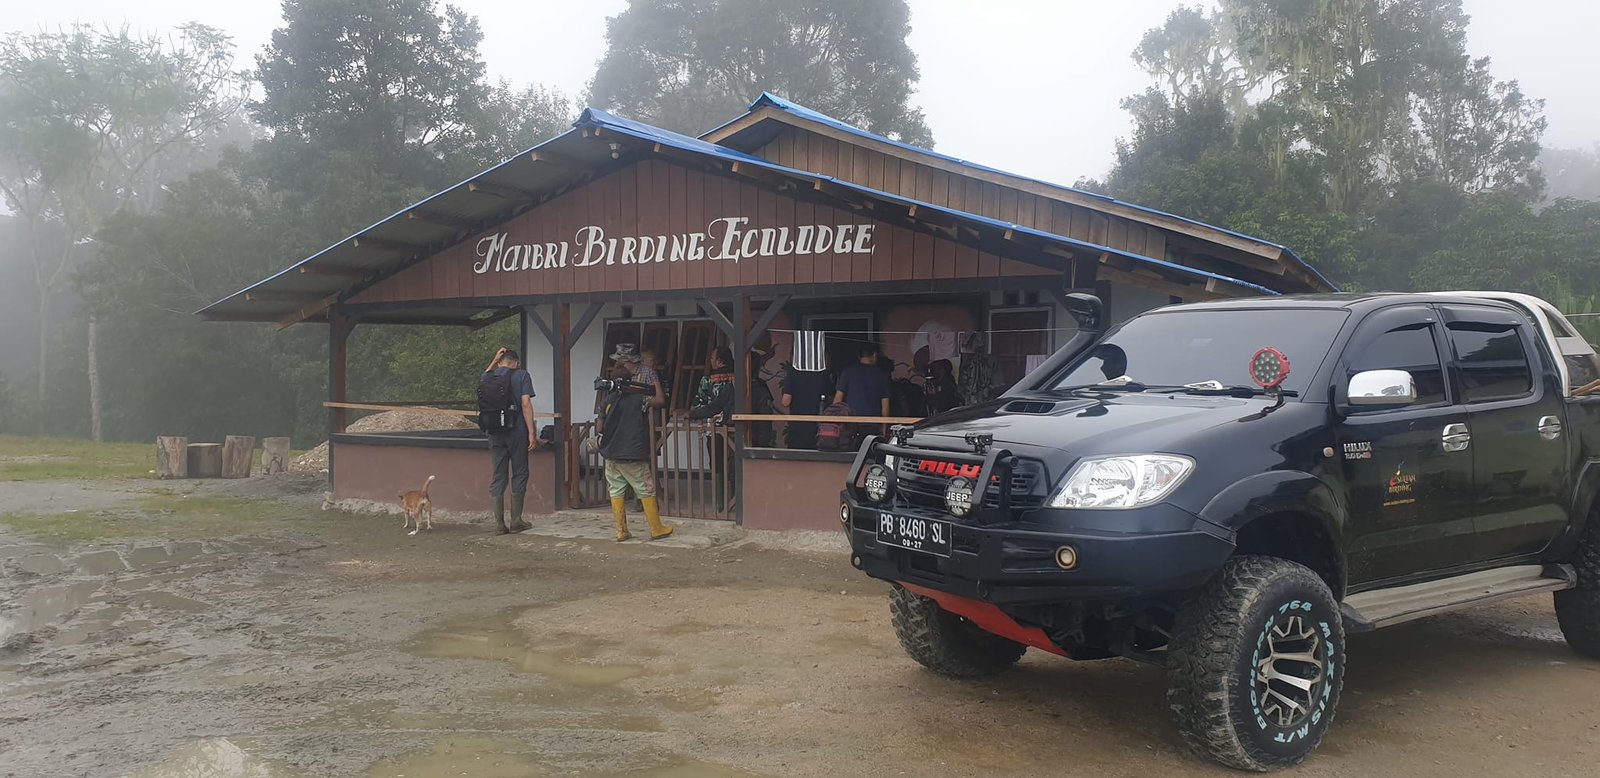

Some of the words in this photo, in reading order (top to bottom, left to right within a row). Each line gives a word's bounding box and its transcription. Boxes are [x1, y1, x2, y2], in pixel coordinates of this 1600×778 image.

[572, 226, 706, 267] BIRDING
[707, 217, 876, 264] ECOLODGE
[1343, 441, 1372, 452] HILUX
[918, 459, 997, 481] HILU
[865, 479, 883, 489] JEEP
[946, 491, 968, 502] JEEP
[880, 513, 894, 534] PB
[899, 516, 926, 540] 8460
[932, 522, 946, 544] SL
[1250, 615, 1275, 730] BIGHORN
[1279, 600, 1312, 615] 764
[1311, 621, 1335, 726] MAXXIS
[1274, 722, 1309, 743] M/T
